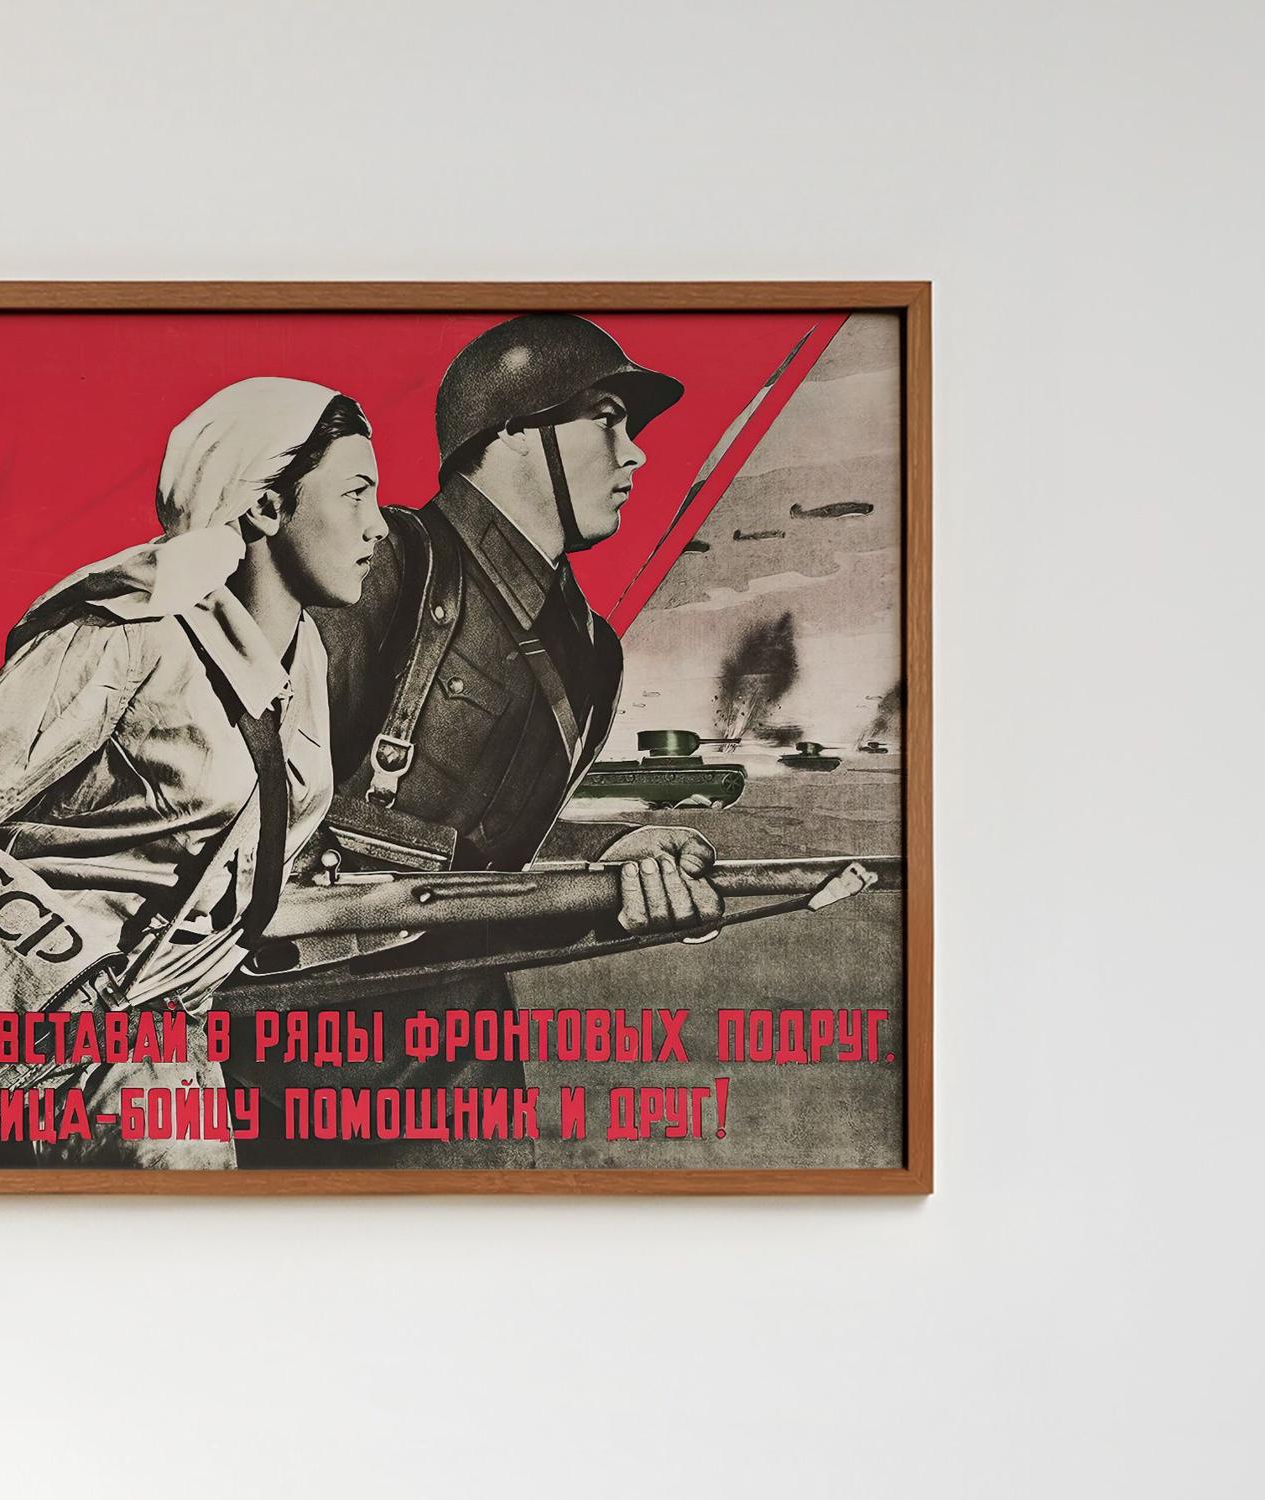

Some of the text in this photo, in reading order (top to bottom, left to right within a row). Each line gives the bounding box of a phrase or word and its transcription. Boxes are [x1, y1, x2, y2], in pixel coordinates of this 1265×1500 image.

[207, 1010, 232, 1063] В
[255, 1010, 384, 1067] РЯДЫ
[404, 1009, 689, 1064] ФРОНТОВЫХ
[718, 1009, 896, 1065] ПОДРУГ.
[284, 1087, 541, 1143] ПОМОЩНИК
[561, 1088, 587, 1141] И
[606, 1077, 730, 1143] ДРУГ!
